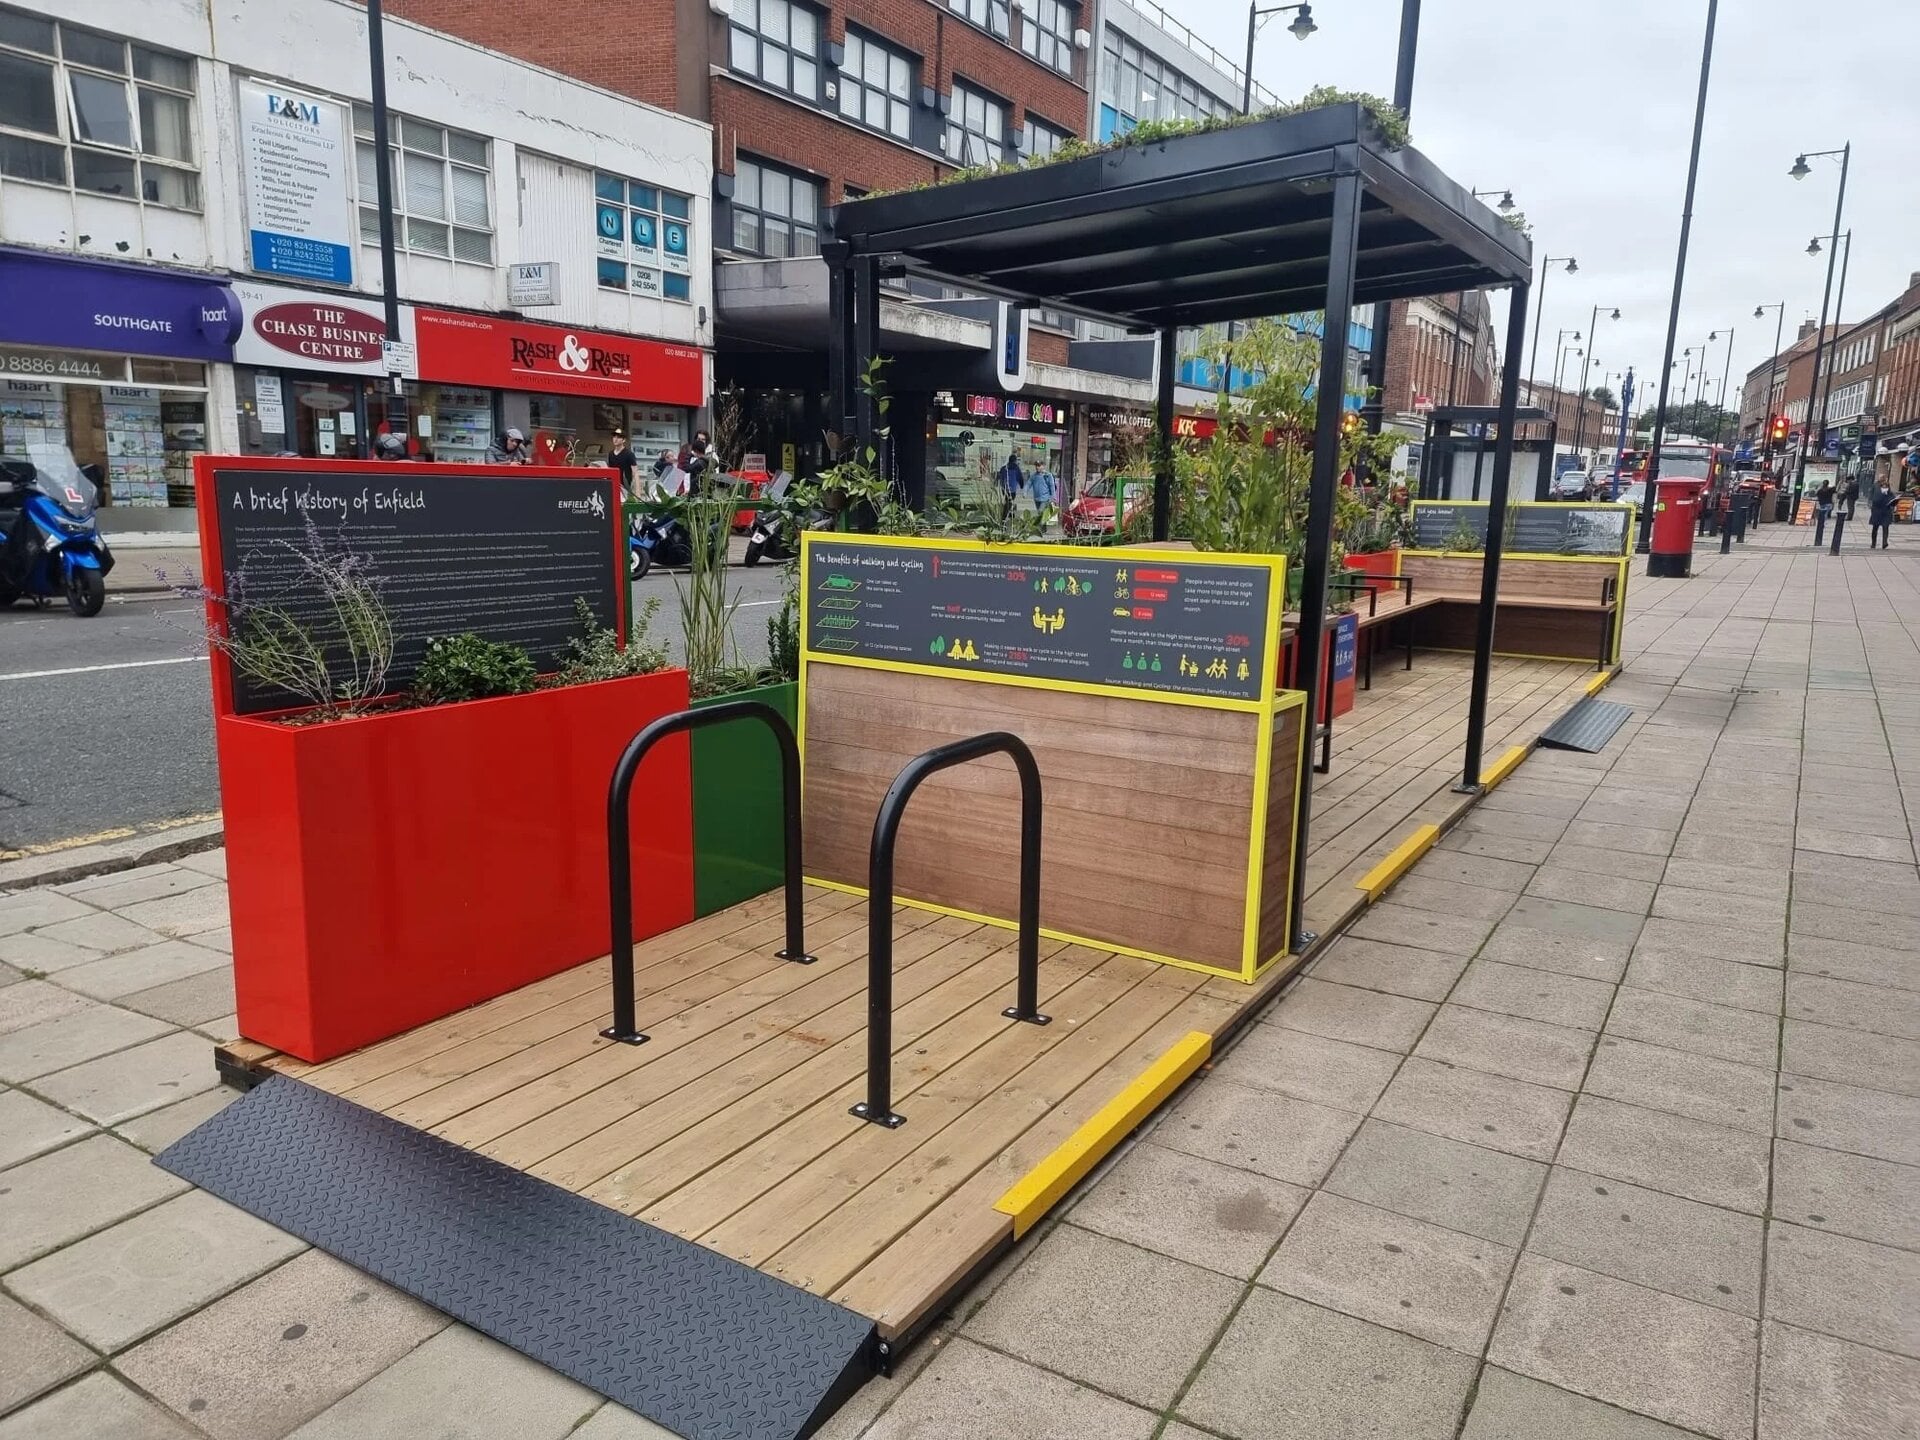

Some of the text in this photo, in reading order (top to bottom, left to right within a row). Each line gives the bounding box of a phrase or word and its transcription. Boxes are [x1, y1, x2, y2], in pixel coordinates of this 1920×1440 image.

[268, 94, 320, 125] E&M
[267, 117, 320, 135] SOLICITORS
[259, 138, 272, 146] Civil
[260, 148, 328, 169] Residential Conveyancing
[260, 157, 330, 178] Commercial Conveyancing
[261, 166, 292, 178] Family Law
[262, 184, 286, 194] Personal
[287, 189, 303, 198] Injury
[263, 194, 287, 204] Landlord
[294, 200, 312, 208] Tenant
[264, 203, 298, 214] Immigration
[265, 212, 299, 223] Employment
[265, 220, 293, 231] Consumer
[606, 216, 678, 244] N L E
[277, 238, 292, 247] 020
[599, 237, 622, 248] Chartered
[634, 245, 654, 255] Certified
[277, 247, 293, 256] 020
[519, 266, 542, 279] E&M
[637, 271, 652, 280] 0208
[631, 279, 657, 291] 242 5540
[241, 291, 263, 301] 39-41
[202, 306, 227, 322] haart
[313, 308, 346, 324] THE
[94, 314, 172, 333] SOUTHGATE
[421, 315, 493, 330] www.rashandrash.com
[261, 319, 386, 346] CHASE BUSINES
[299, 341, 364, 360] CENTRE
[558, 334, 590, 373] &
[9, 356, 55, 374] 8886
[58, 360, 102, 377] 4444
[8, 379, 52, 393] haart
[109, 386, 150, 398] haart
[1128, 416, 1152, 428] COFFEE
[1177, 418, 1198, 436] KFC
[233, 487, 426, 520] A brief history of Enfield
[557, 500, 589, 509] ENFIELD
[1427, 509, 1437, 518] you
[815, 553, 924, 573] The benefits of walking and cycling
[1049, 566, 1064, 574] cycling
[1185, 578, 1203, 586] People
[1215, 579, 1228, 587] walk
[1240, 590, 1253, 598] high
[1212, 645, 1225, 653] high
